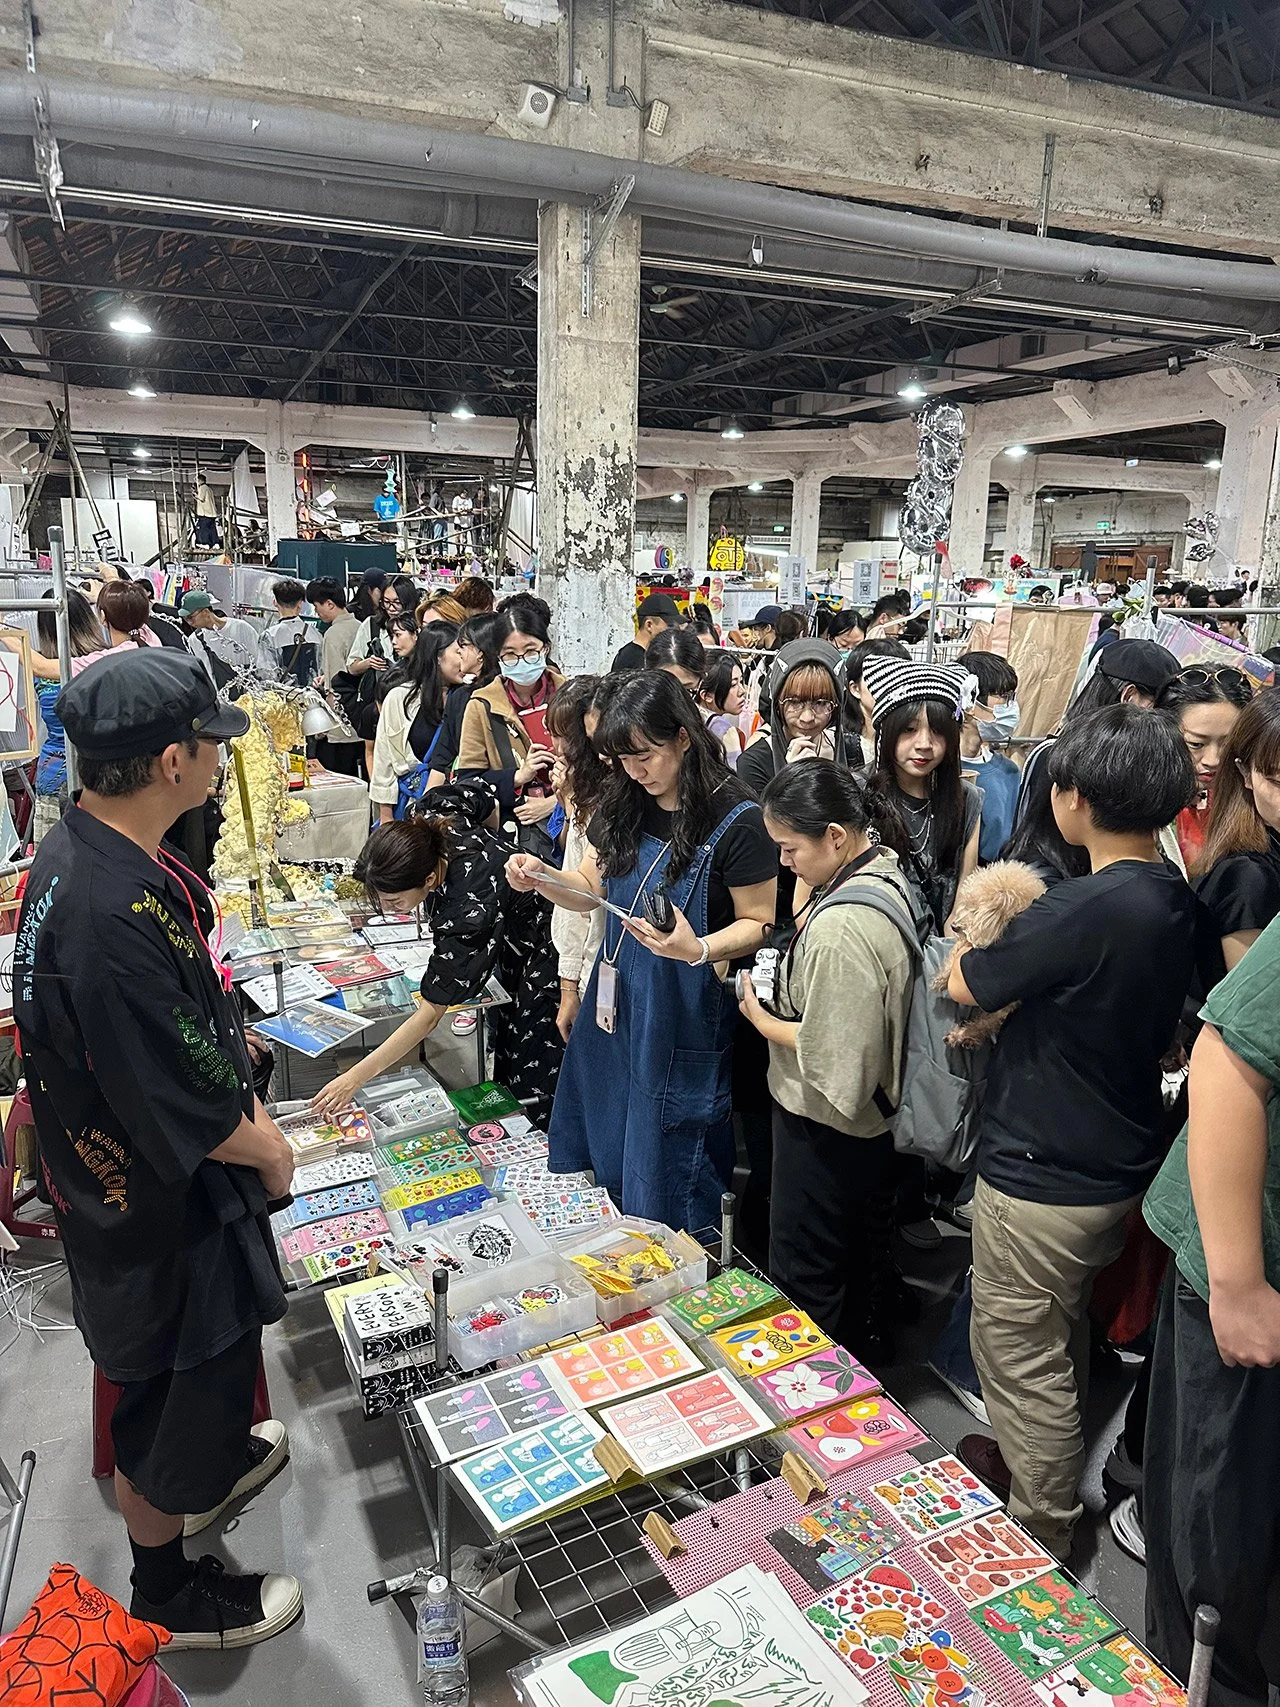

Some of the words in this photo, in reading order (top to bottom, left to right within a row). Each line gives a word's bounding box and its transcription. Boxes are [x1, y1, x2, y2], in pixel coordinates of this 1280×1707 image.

[354, 1300, 381, 1332] EVERY
[376, 1292, 408, 1328] PERSON
[402, 1301, 418, 1313] IN
